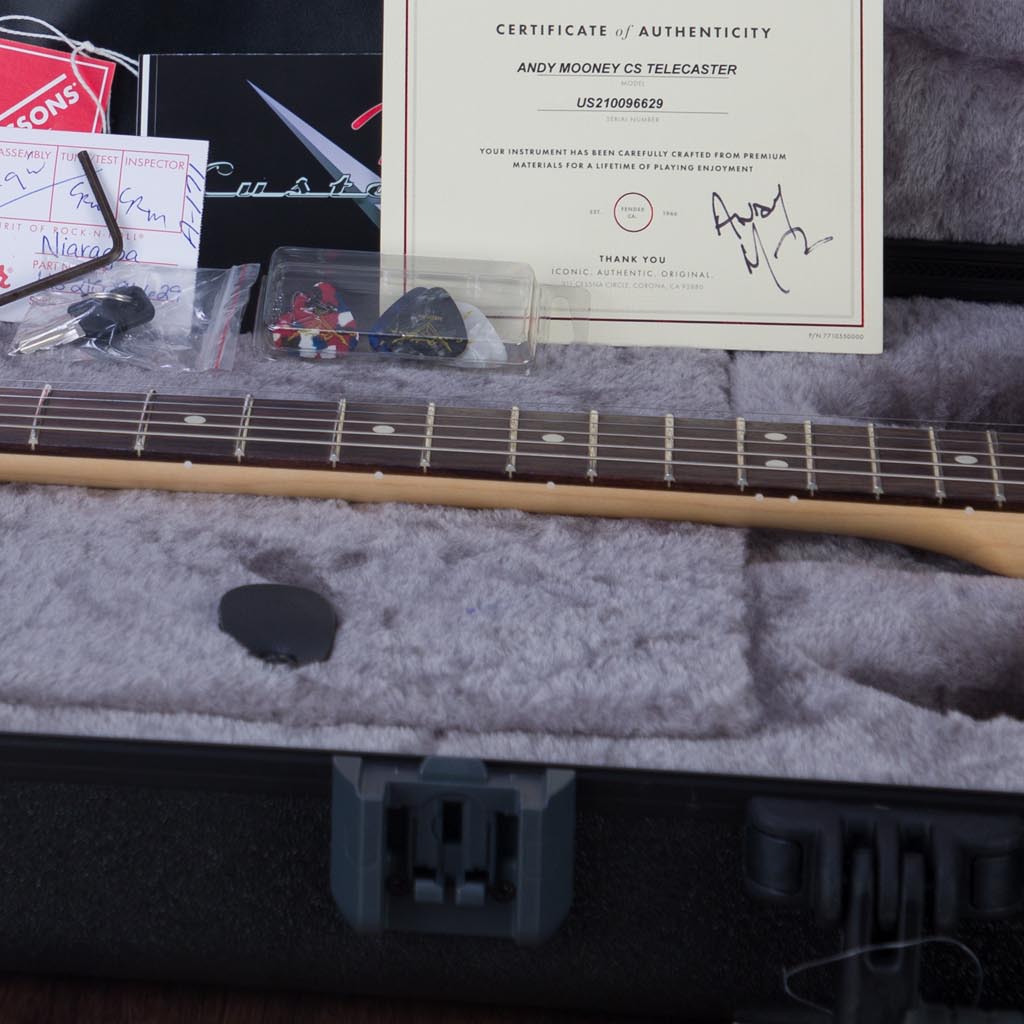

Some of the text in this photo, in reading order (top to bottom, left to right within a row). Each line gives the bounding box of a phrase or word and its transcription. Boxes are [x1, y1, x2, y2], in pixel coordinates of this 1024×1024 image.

[496, 24, 770, 39] CERTIFICATE of AUTHENTICITY
[517, 62, 737, 75] ANDY MOONEY CS TELECASTER
[577, 97, 663, 108] US210096629
[126, 157, 184, 170] INSPECTOR
[30, 224, 44, 233] OF
[642, 256, 665, 264] YOU
[551, 268, 713, 278] ICONIC. AUTHENTIC. ORIGINAL.
